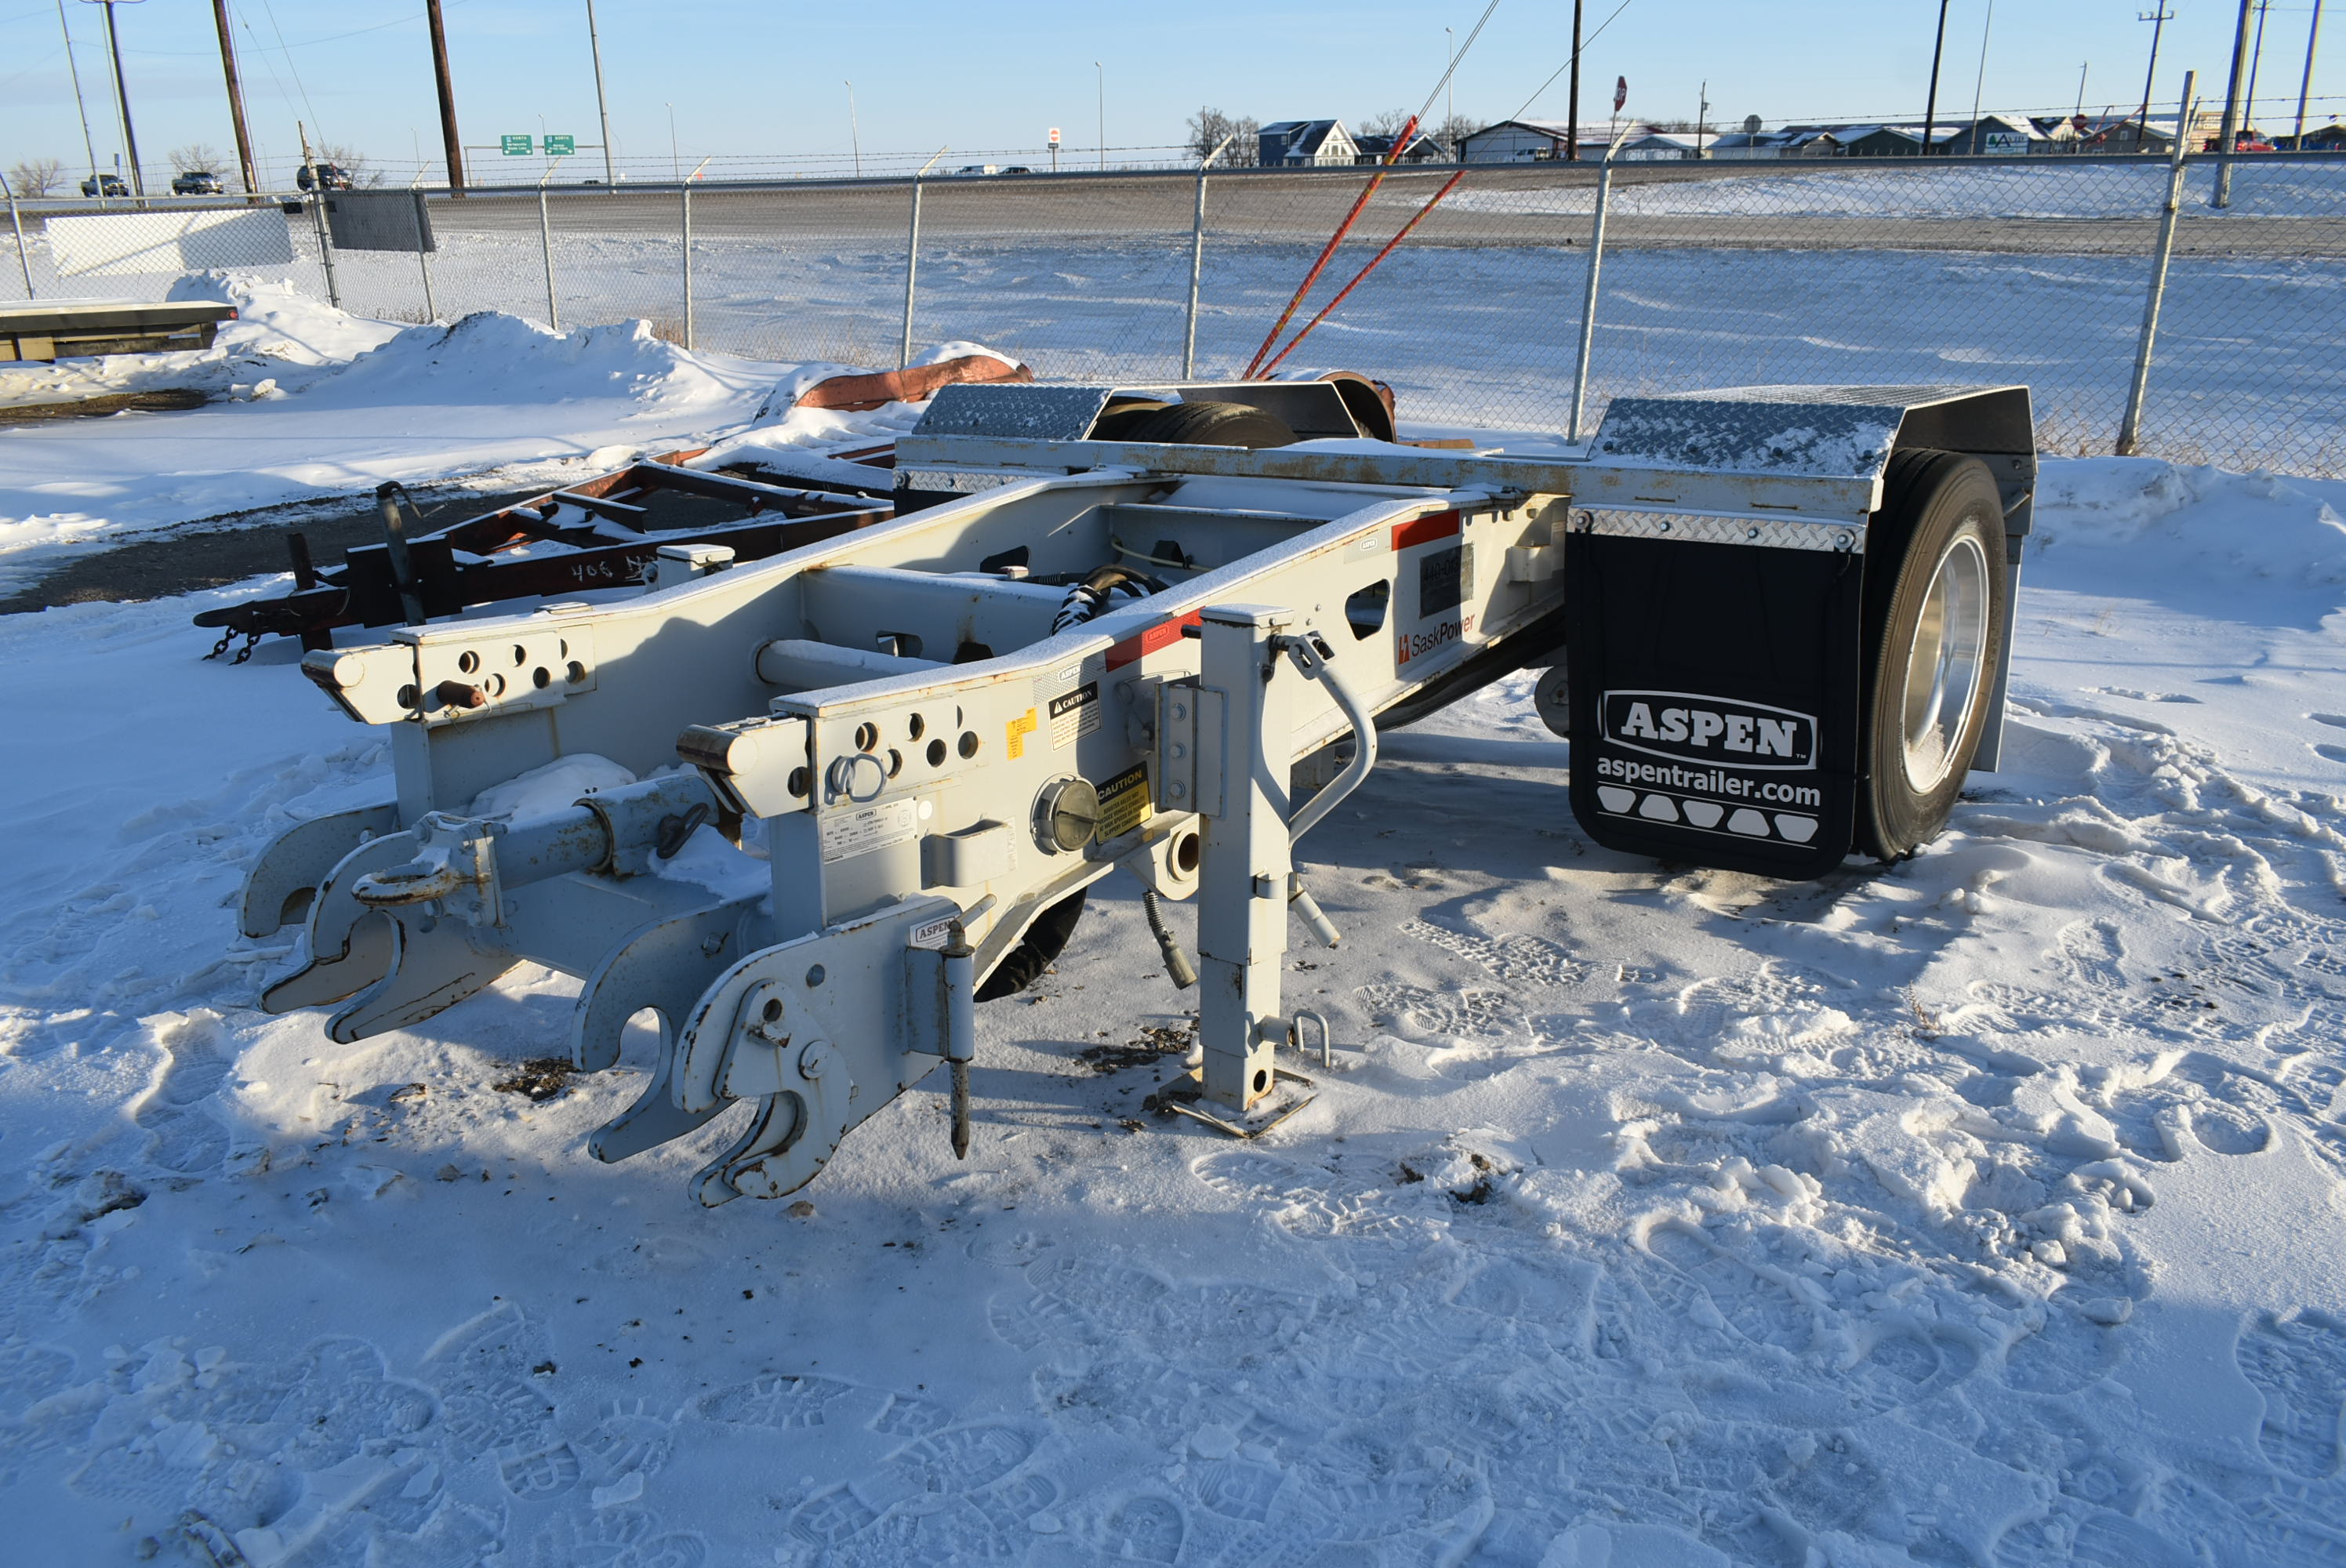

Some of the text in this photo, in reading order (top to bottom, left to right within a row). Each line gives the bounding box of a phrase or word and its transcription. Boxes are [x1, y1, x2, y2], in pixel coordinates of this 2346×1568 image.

[1411, 614, 1476, 658] SaskPower
[1062, 690, 1092, 709] CAUTION
[1621, 702, 1797, 757] ASPEN
[1098, 769, 1142, 800] CAUTION
[1597, 757, 1820, 807] aspentrailer.com
[858, 811, 874, 819] ASPEN
